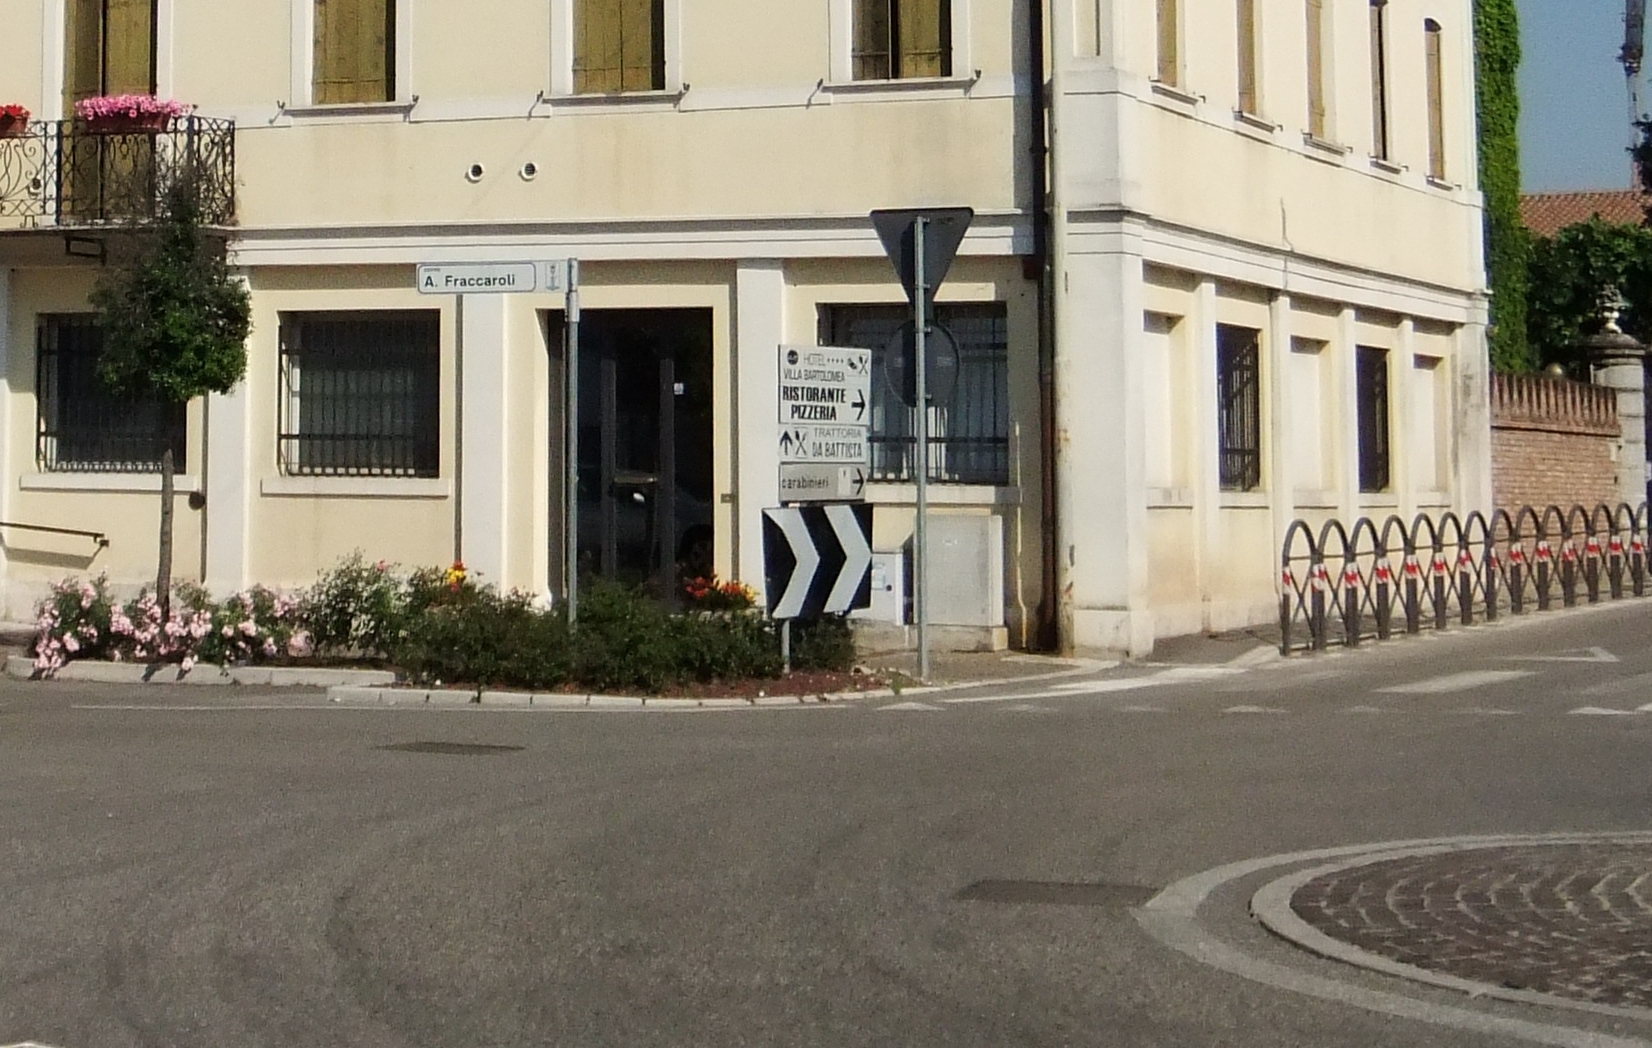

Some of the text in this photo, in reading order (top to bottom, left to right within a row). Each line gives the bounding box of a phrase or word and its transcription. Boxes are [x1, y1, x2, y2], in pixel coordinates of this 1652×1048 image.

[424, 274, 516, 288] A. Fraccaroli
[783, 368, 802, 381] VILLA
[782, 385, 846, 403] RISTORANTE
[791, 404, 837, 421] PIZZERIA
[814, 427, 862, 438] TRATTORIA
[812, 441, 862, 458] DA BATTISTA
[781, 476, 829, 489] carabinieri
